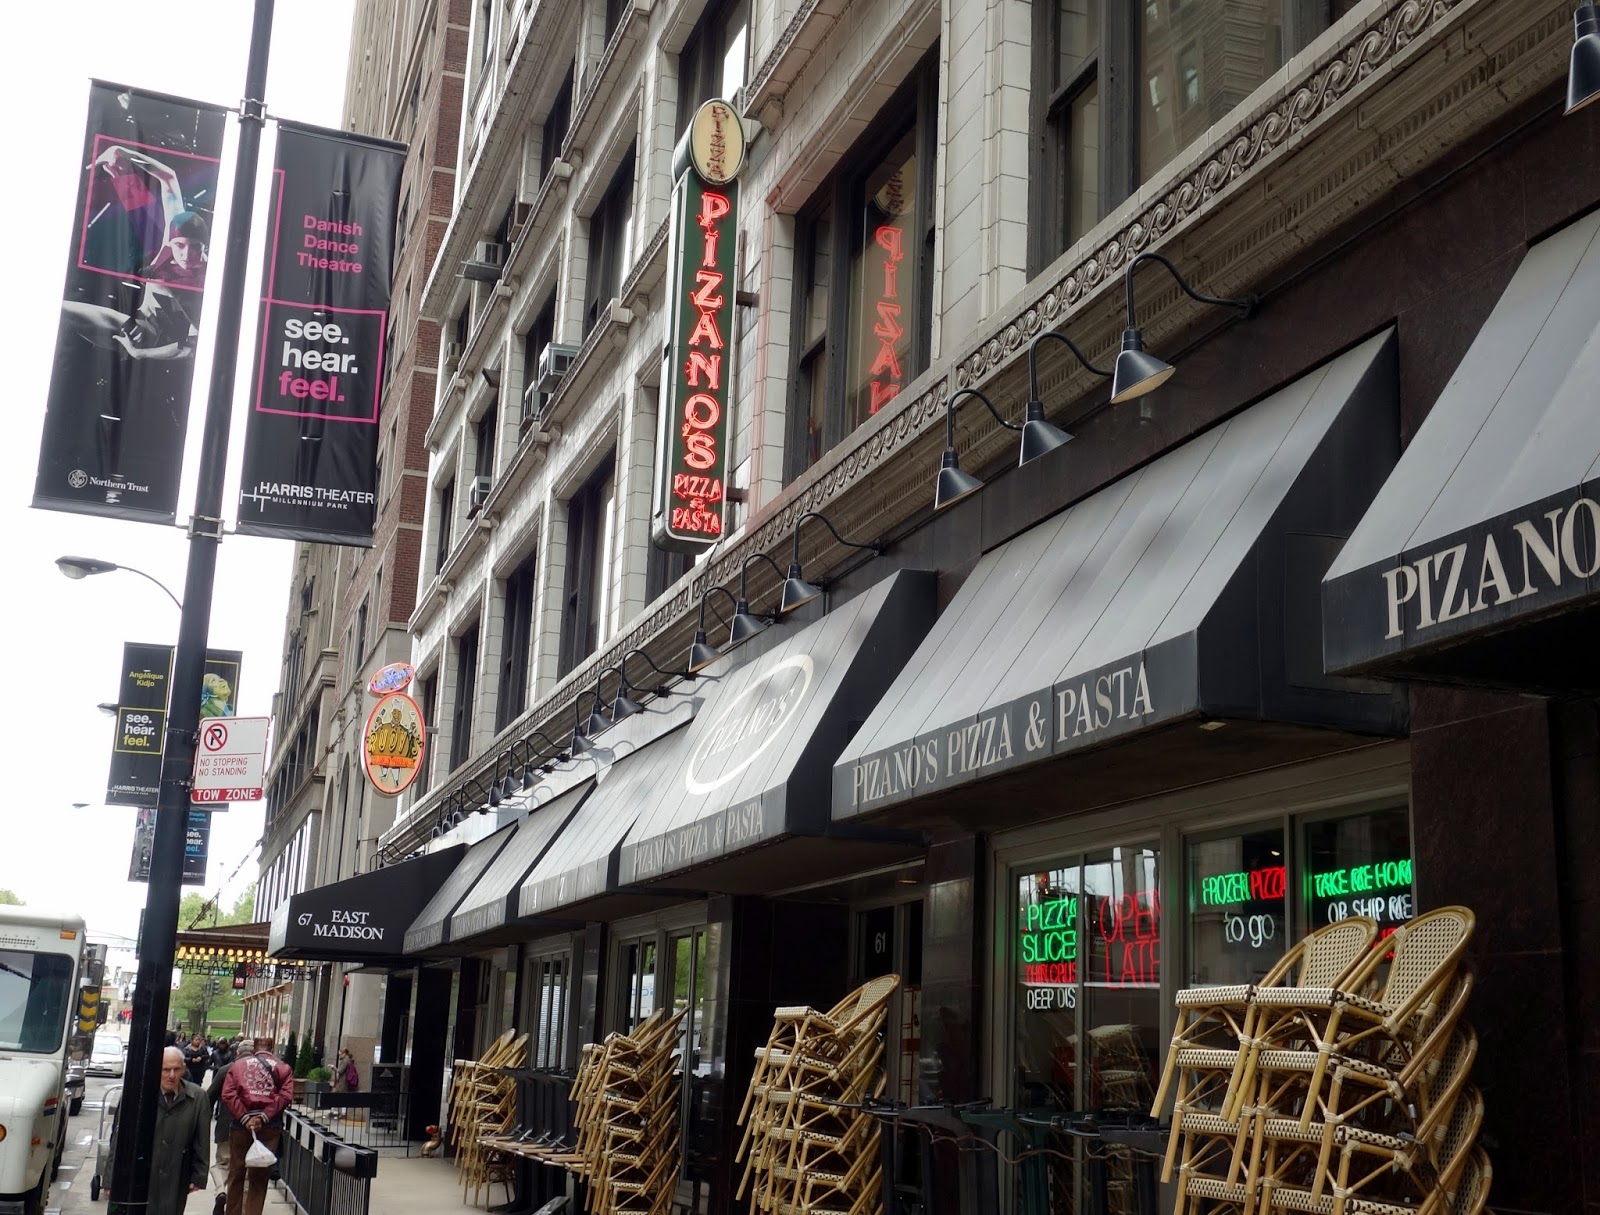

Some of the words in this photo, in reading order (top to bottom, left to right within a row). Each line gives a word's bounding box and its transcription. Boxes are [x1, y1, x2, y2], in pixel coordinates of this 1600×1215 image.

[303, 214, 363, 237] Danish
[303, 234, 359, 254] Dance
[297, 252, 363, 274] Theatre
[284, 318, 349, 344] see.
[281, 341, 359, 374] hear.
[278, 370, 345, 402] feel.
[89, 476, 126, 490] Northern
[127, 482, 149, 493] Trust
[260, 481, 314, 498] HARRIS
[315, 487, 375, 504] THEATER
[673, 473, 722, 502] PIZZA
[272, 497, 323, 507] MILLENNIUM
[671, 507, 721, 534] PASTA
[136, 680, 155, 688] Kidjo
[125, 723, 156, 736] hear.
[126, 714, 152, 724] see.
[123, 735, 150, 747] feel.
[851, 738, 938, 806] PIZANO'S
[945, 712, 1014, 778] PIZZA
[1024, 701, 1046, 751] &
[1056, 662, 1154, 743] PASTA
[198, 768, 210, 777] NO
[211, 767, 247, 777] STANDING
[199, 758, 211, 767] NO
[213, 757, 248, 767] STOPPING
[196, 789, 220, 801] TOW
[226, 789, 256, 801] ZONE
[633, 834, 676, 876] PIZANO'S
[679, 823, 709, 859] PIZZA
[712, 816, 723, 849] &
[726, 802, 764, 844] PASTA
[1202, 872, 1251, 905] FROZEN
[1314, 869, 1349, 898] TAKE
[297, 912, 313, 926] 67
[331, 910, 370, 925] EAST
[1328, 902, 1348, 923] OR
[1352, 896, 1385, 921] SHIP
[313, 923, 384, 940] MADISON
[1223, 911, 1245, 943] to
[1249, 913, 1275, 948] go
[875, 931, 887, 954] 61
[1022, 930, 1077, 962] SLICE
[1027, 988, 1054, 1009] DEEP
